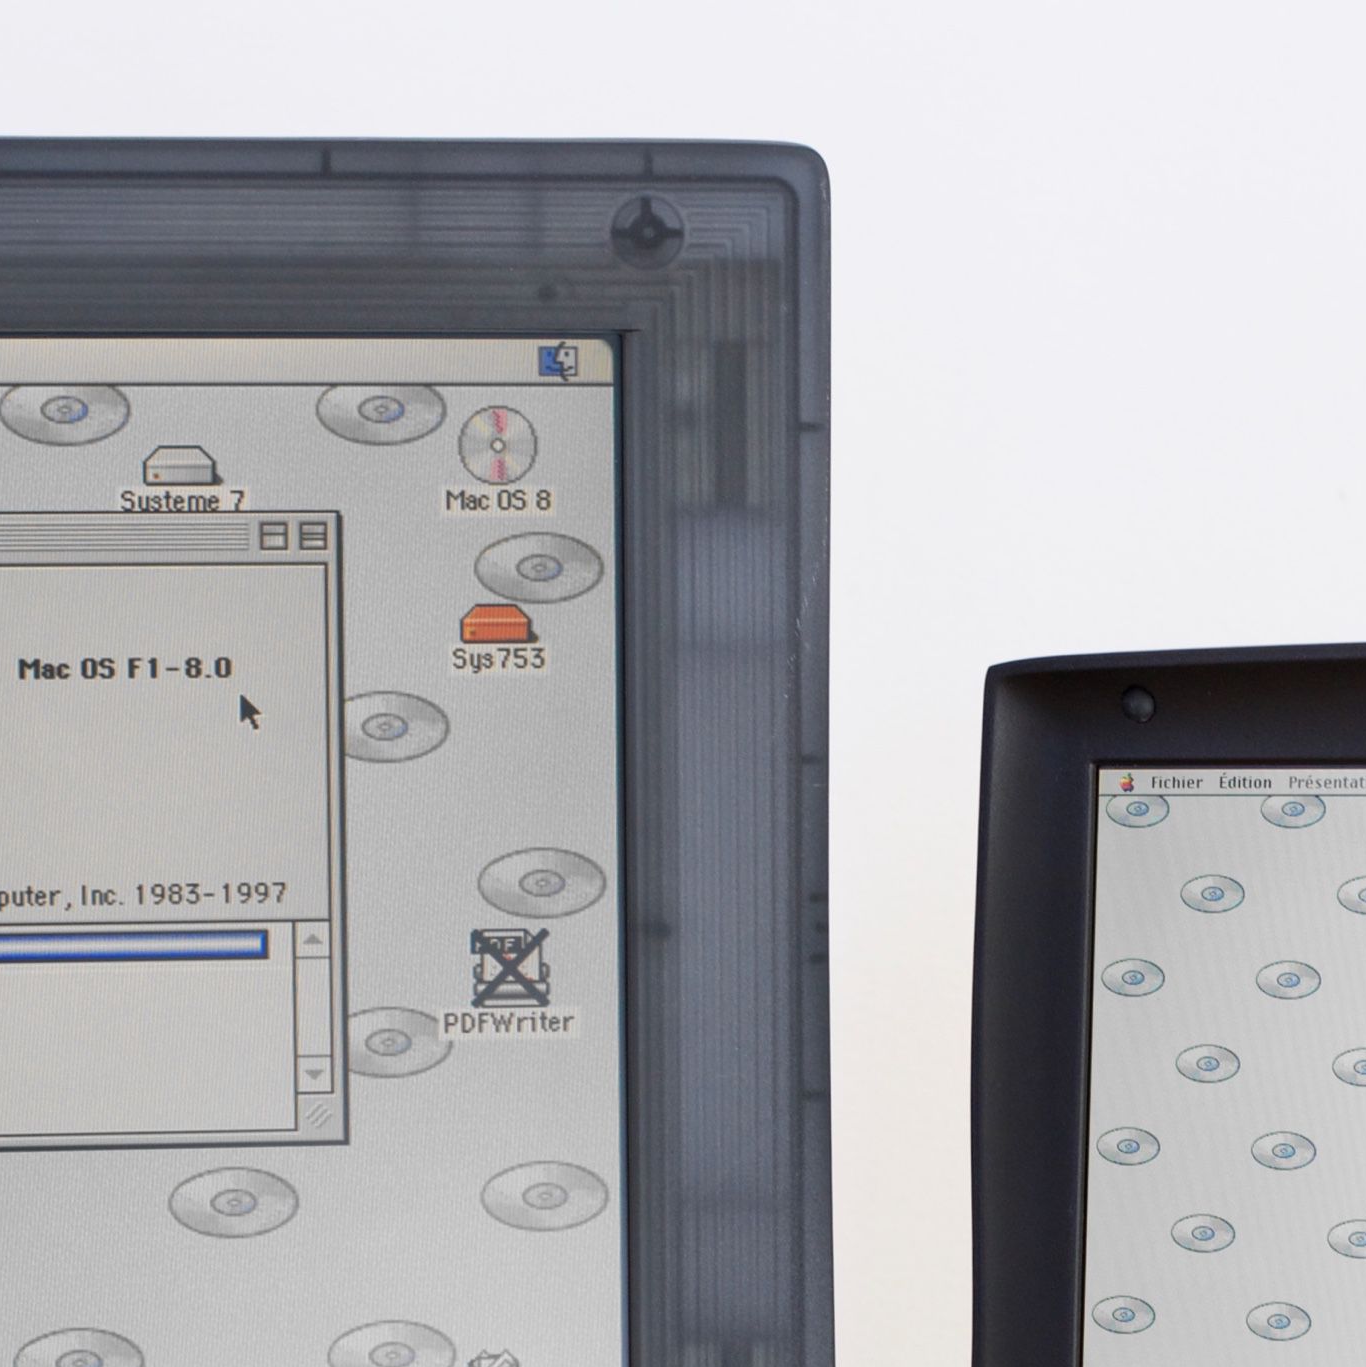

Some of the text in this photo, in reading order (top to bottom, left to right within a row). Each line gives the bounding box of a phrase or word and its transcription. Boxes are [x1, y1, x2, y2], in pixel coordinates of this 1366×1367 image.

[231, 490, 246, 510] 7
[446, 490, 551, 511] Mac OS 8
[18, 659, 69, 680] Mac
[81, 658, 116, 680] OS
[1151, 776, 1203, 789] Fichier
[1219, 773, 1272, 789] Édition
[81, 884, 124, 907] Inc.
[136, 882, 288, 906] 1983-1997
[444, 1012, 574, 1034] PDFWriter
